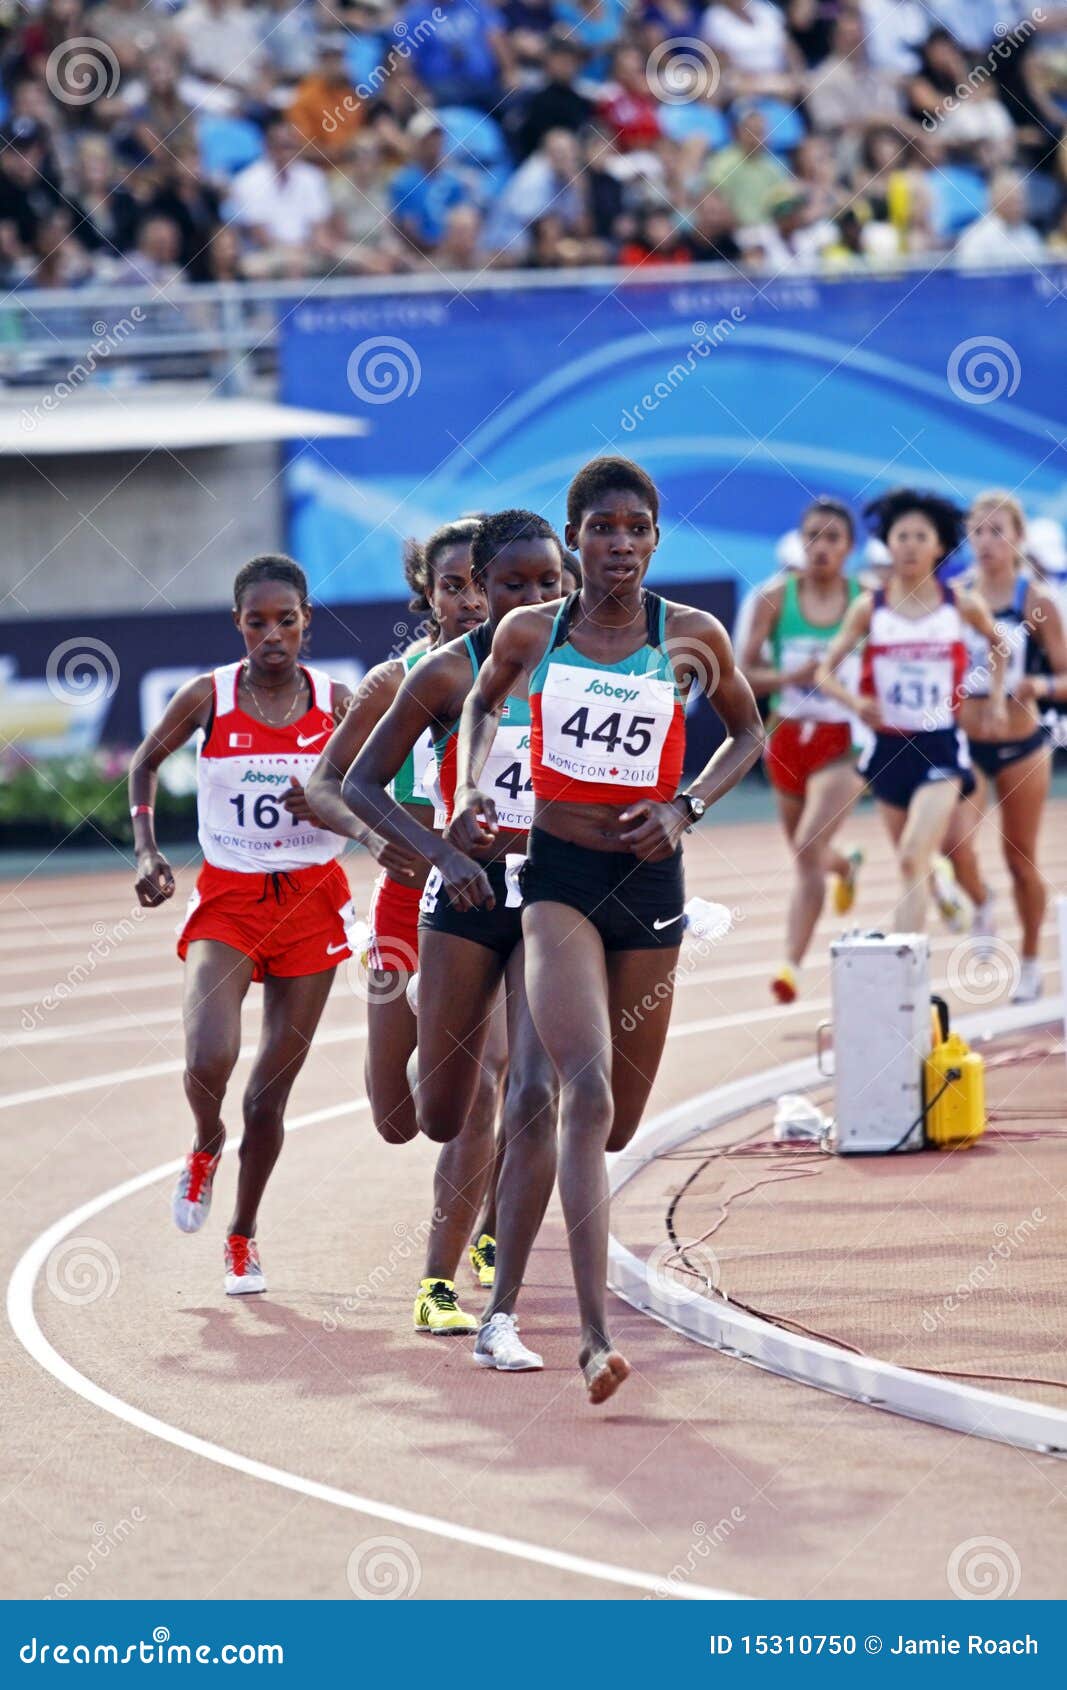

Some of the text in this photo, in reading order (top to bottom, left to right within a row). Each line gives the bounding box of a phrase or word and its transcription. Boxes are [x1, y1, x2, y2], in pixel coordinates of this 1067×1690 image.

[585, 679, 640, 702] Sobeys
[561, 706, 656, 757] 445
[241, 770, 289, 786] Sobeys
[548, 752, 655, 782] MONCTON 2010
[229, 793, 299, 829] 16
[498, 811, 533, 825] NCTO
[211, 833, 315, 850] MONCTON 2010
